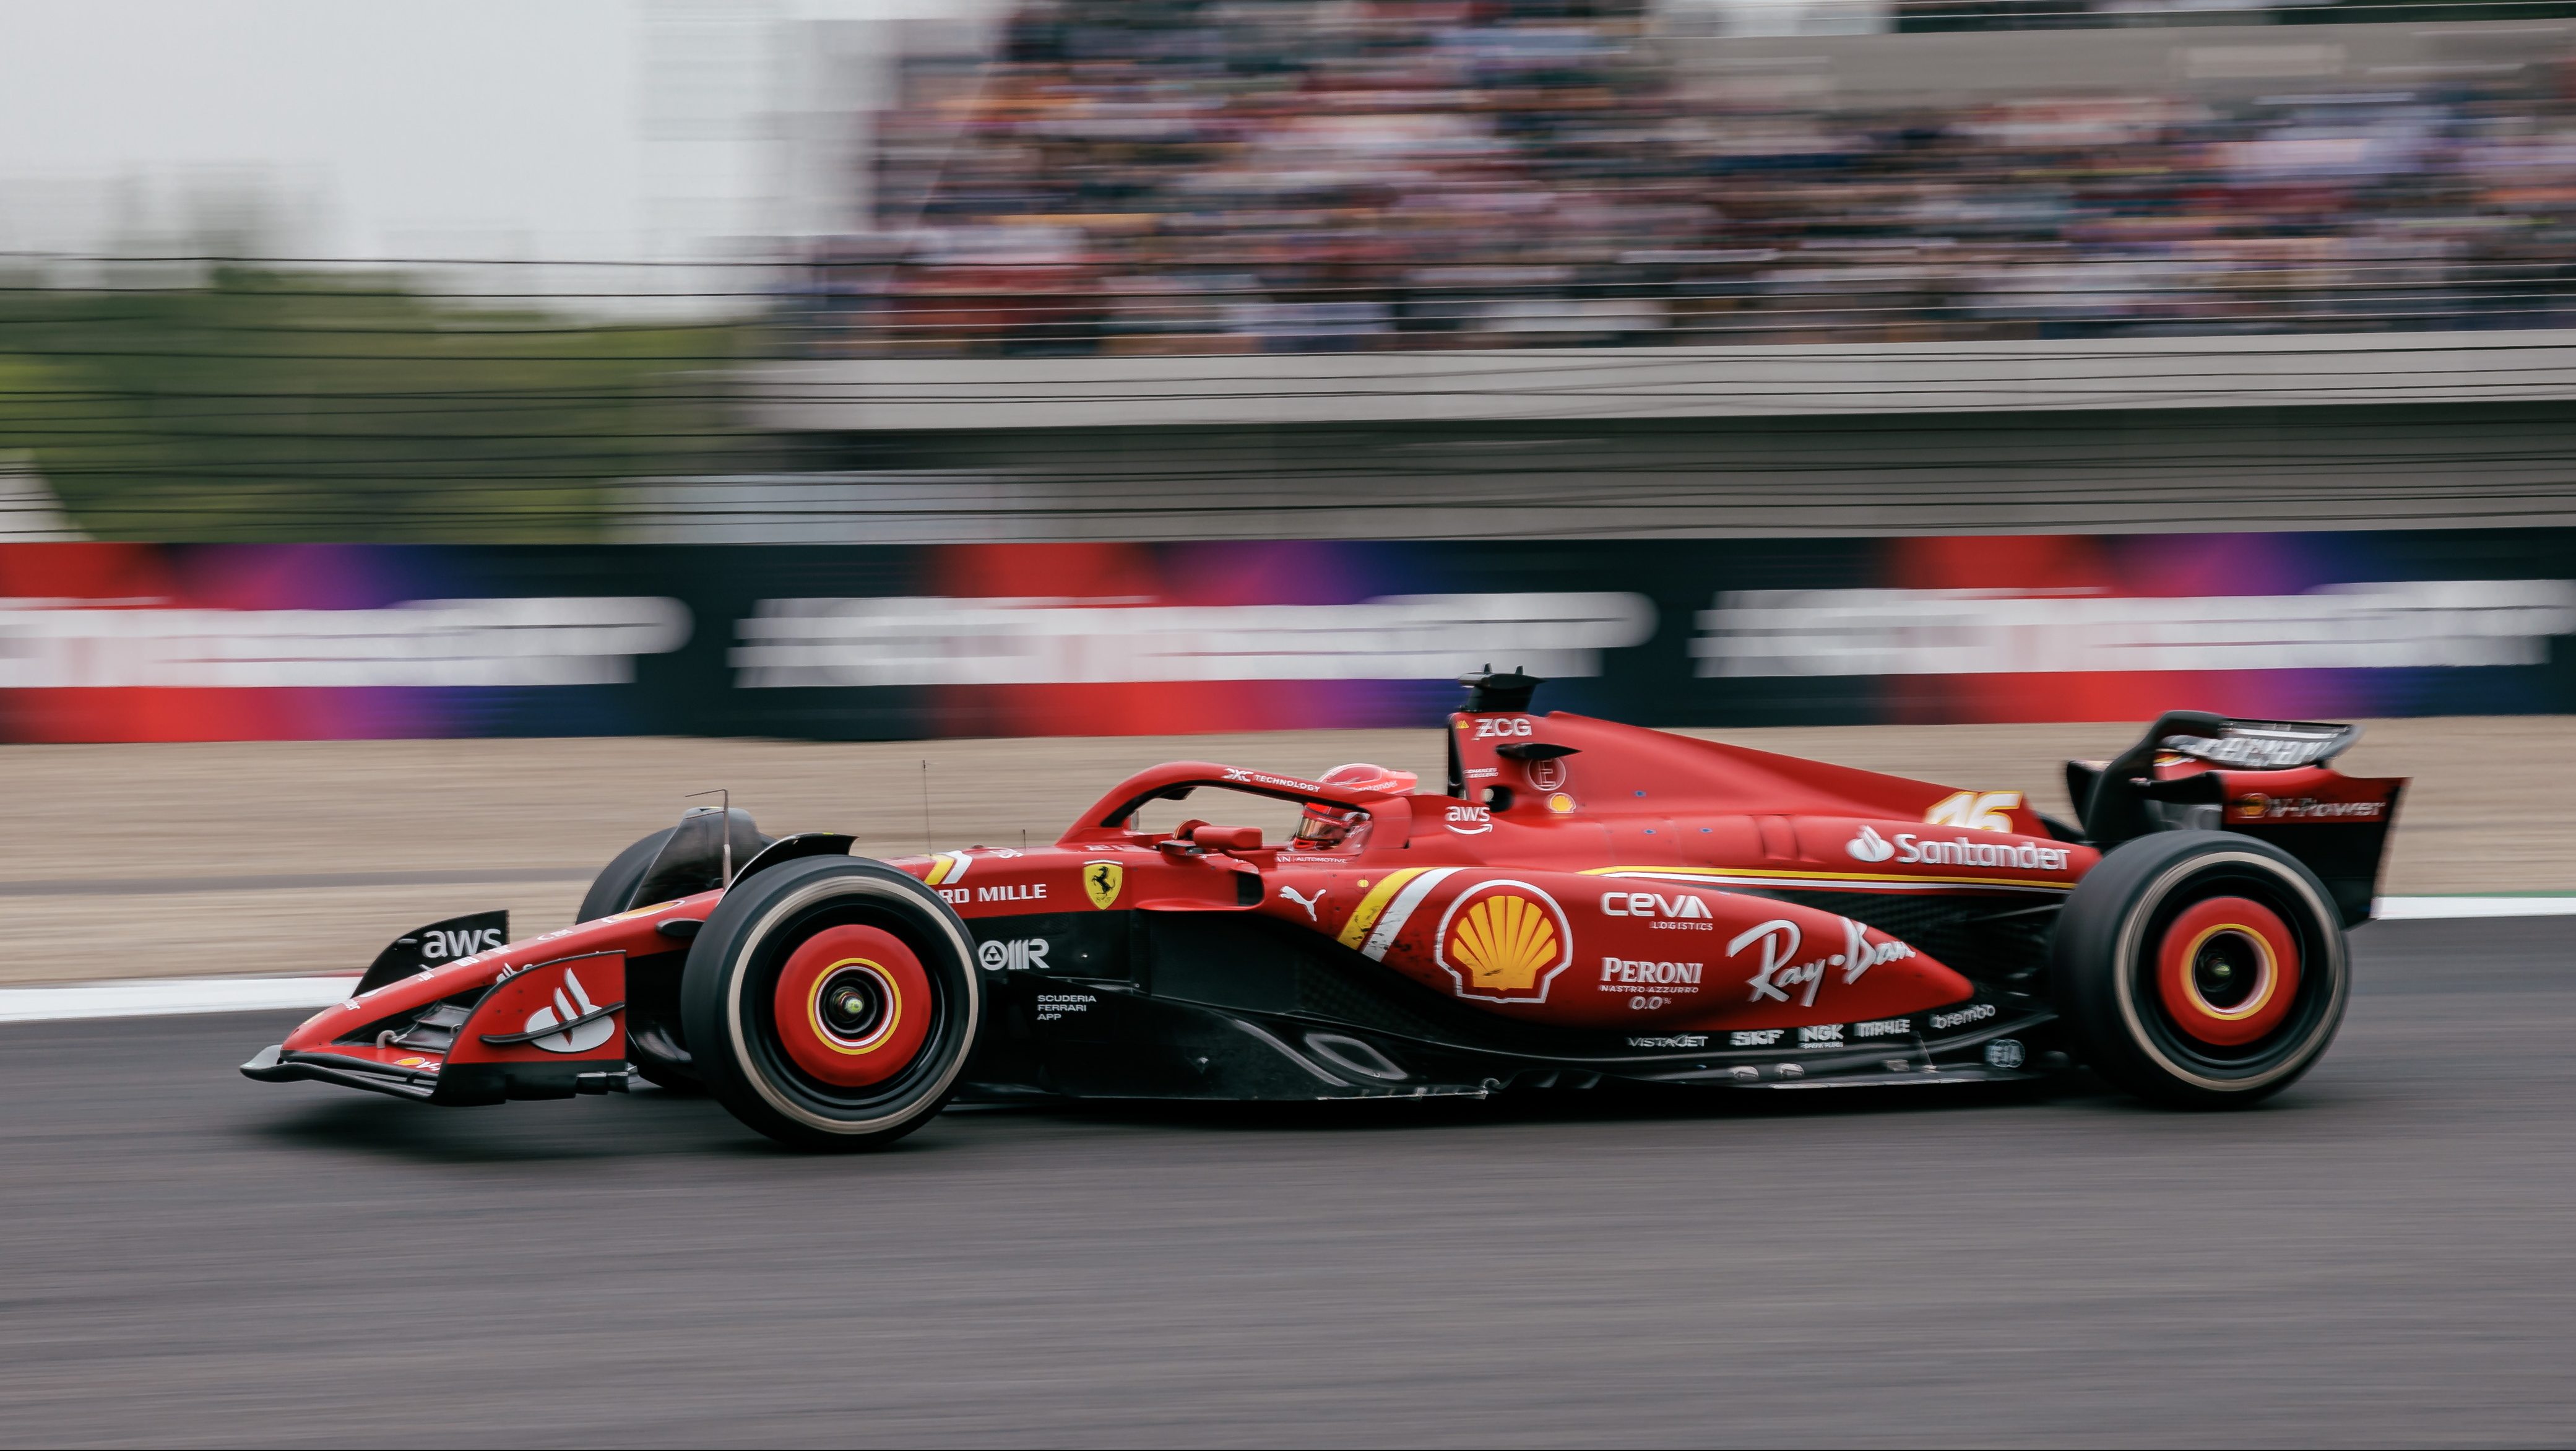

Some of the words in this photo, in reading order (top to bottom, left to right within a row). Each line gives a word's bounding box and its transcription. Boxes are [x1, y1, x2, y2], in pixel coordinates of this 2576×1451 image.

[1473, 718, 1532, 737] ZCG
[1253, 774, 1321, 792] TECHNOLOGY
[1445, 806, 1490, 822] aws
[1893, 833, 2071, 870] Santander
[938, 888, 970, 904] RD
[977, 883, 1047, 902] MILLE
[1649, 921, 1713, 930] LOGISTICS
[421, 928, 503, 958] aws
[1600, 957, 1703, 984] PERONI
[1726, 916, 1916, 1007] Ray-Ban
[1597, 985, 1645, 993] NASTRO
[1929, 1004, 1995, 1029] brembo
[1730, 1029, 1784, 1046] SKF
[1798, 1023, 1844, 1042] NGK
[1854, 1019, 1911, 1037] MAHLE
